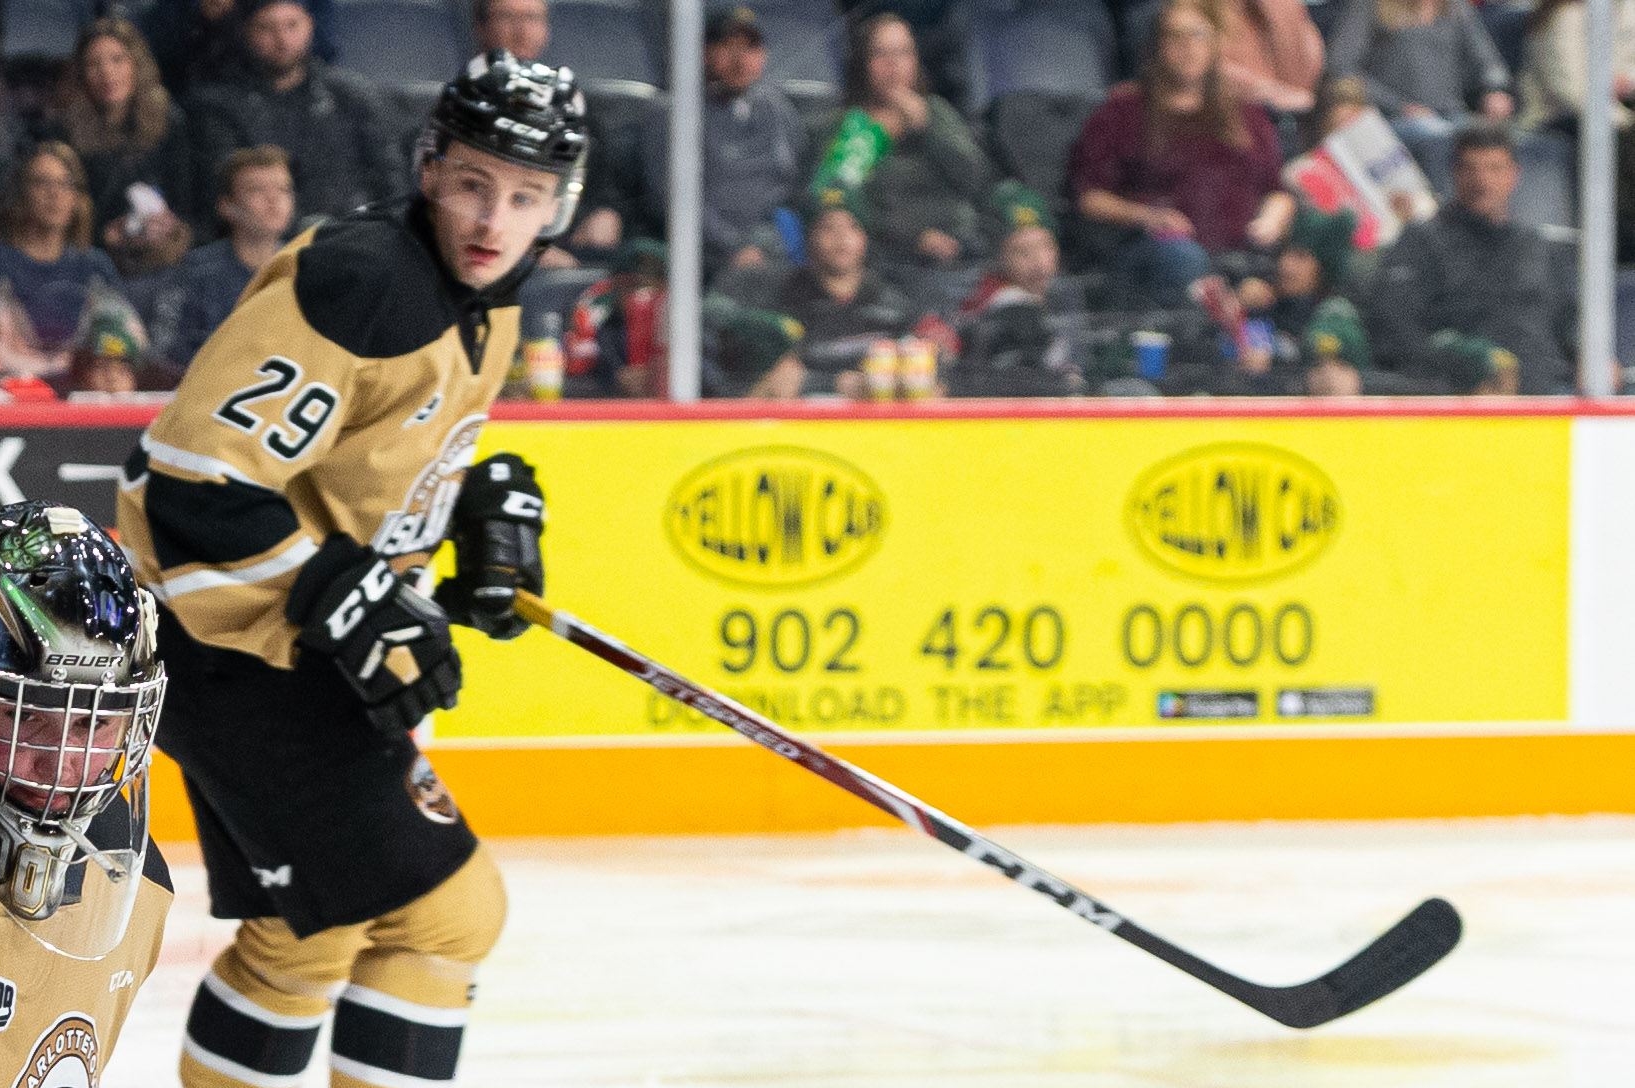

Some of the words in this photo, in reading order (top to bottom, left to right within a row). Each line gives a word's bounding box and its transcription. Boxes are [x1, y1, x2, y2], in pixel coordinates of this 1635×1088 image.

[494, 117, 548, 141] CCM
[211, 354, 342, 463] 29
[671, 470, 813, 564] YELLOW
[819, 478, 884, 556] CAB
[1132, 468, 1270, 560] YELLOW
[1278, 477, 1338, 552] CAB
[720, 607, 862, 673] 902
[920, 605, 1065, 670] 420
[1123, 603, 1313, 669] 0000
[933, 686, 1016, 722] THE
[1041, 683, 1126, 721] APP
